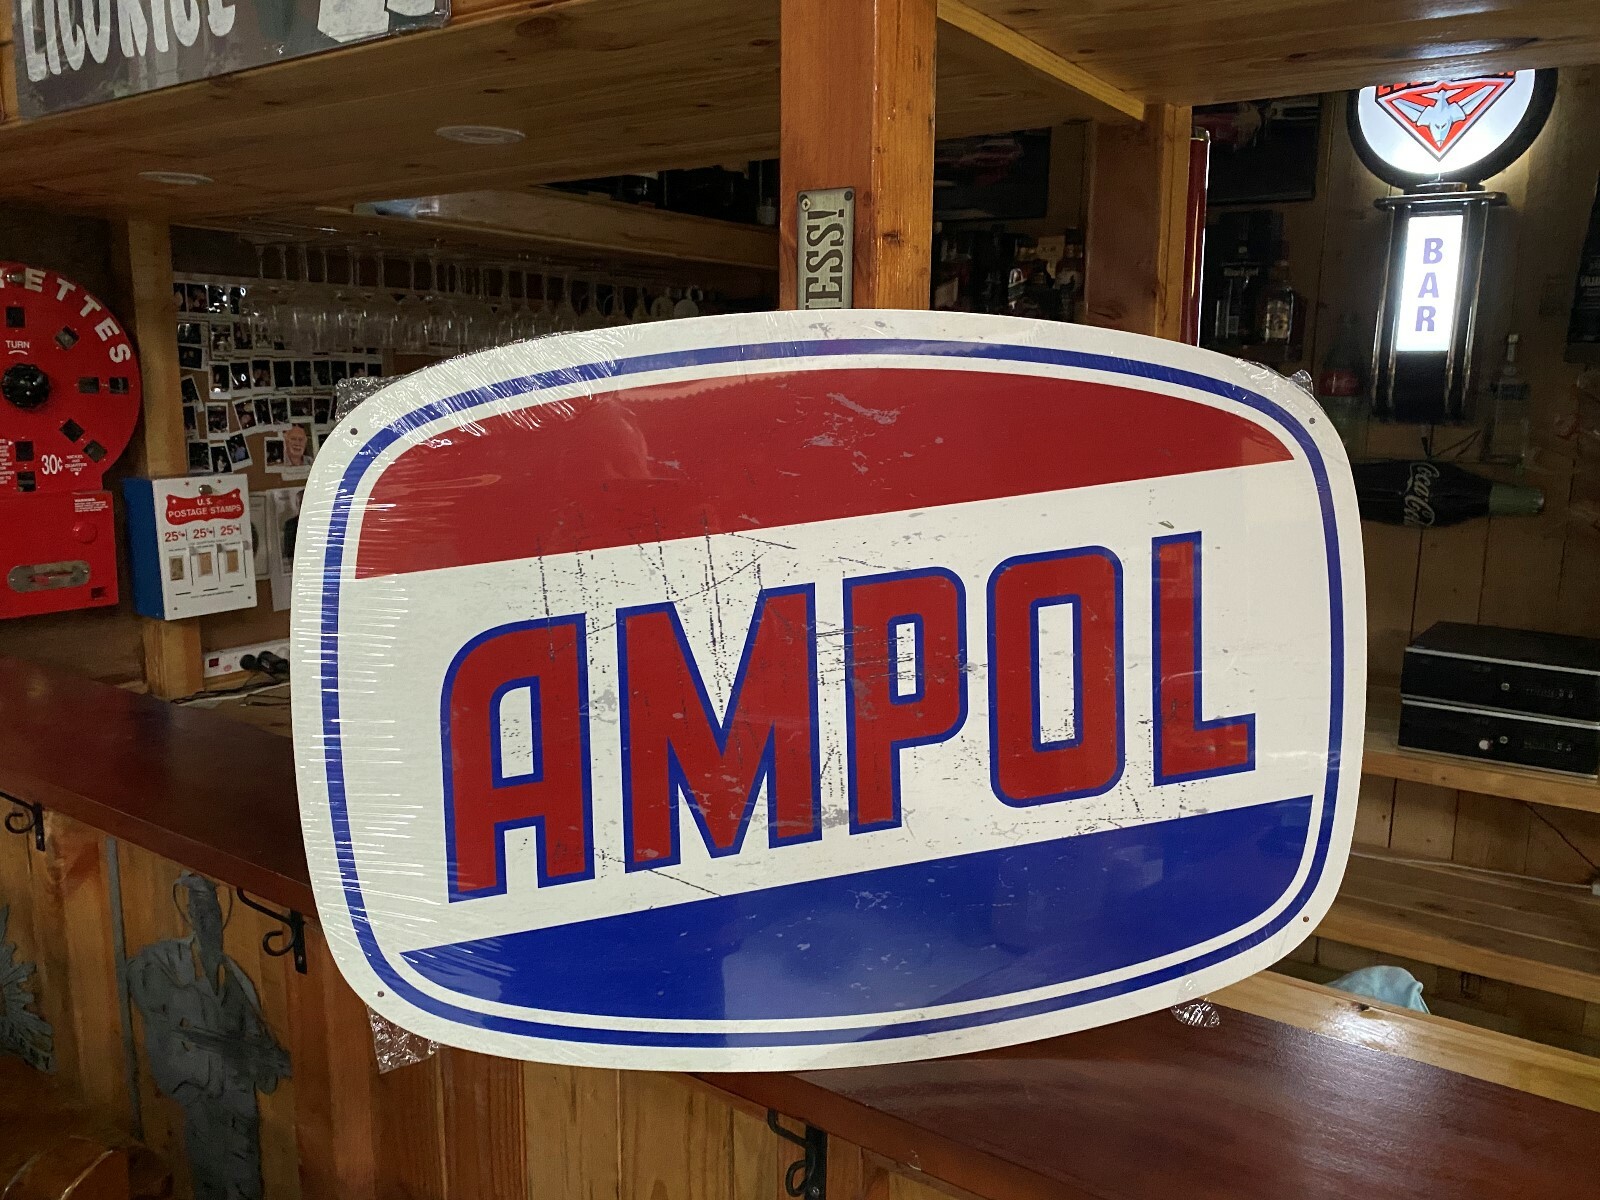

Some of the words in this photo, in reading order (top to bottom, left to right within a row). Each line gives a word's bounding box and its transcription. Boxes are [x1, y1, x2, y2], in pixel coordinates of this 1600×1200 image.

[805, 209, 845, 309] ESS!
[1414, 237, 1444, 332] BAR
[0, 267, 131, 364] ETTES
[5, 339, 30, 349] TURN
[41, 454, 63, 475] 30¢
[168, 507, 208, 518] POSTAGE
[210, 504, 242, 515] STAMPS
[440, 531, 1257, 903] AMPOL
